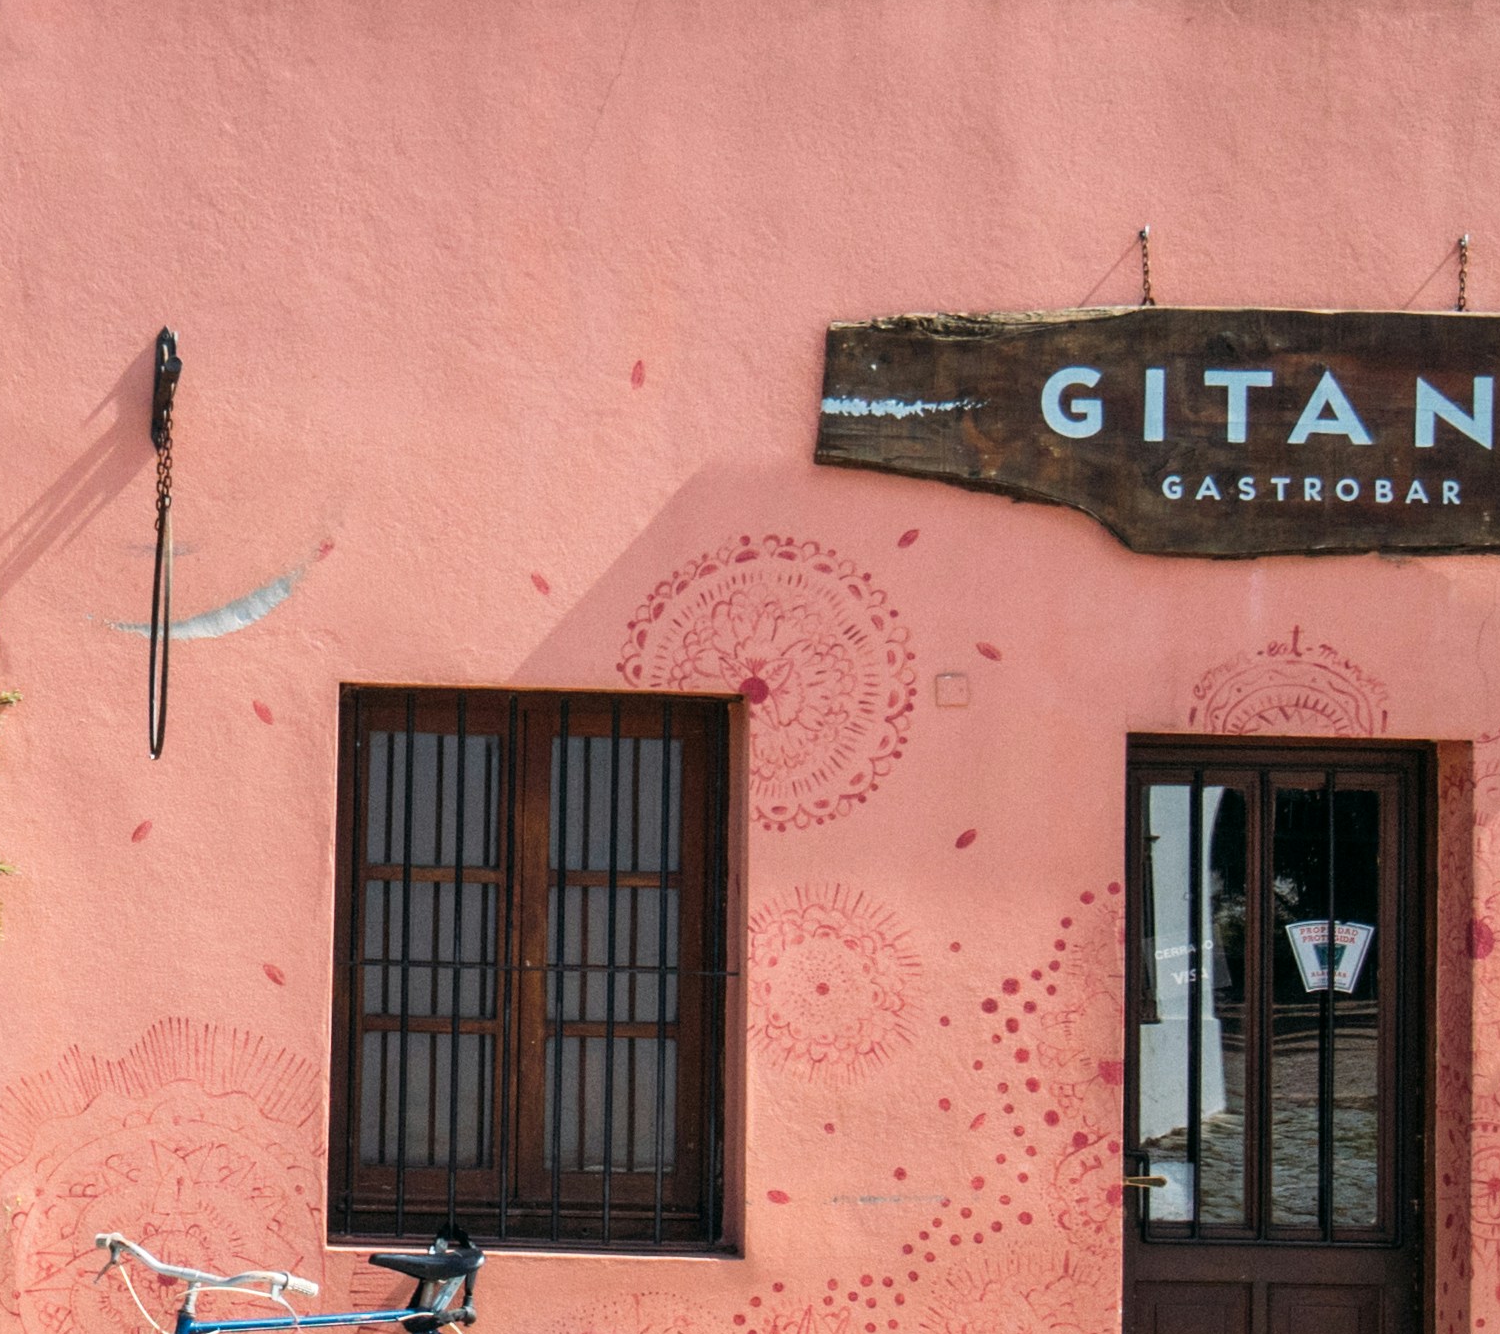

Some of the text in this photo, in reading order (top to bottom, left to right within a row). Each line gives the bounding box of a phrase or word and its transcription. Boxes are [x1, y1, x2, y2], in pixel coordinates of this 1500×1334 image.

[1160, 475, 1462, 505] GASTROBAR
[1300, 926, 1359, 936] PROPDAD
[1154, 939, 1214, 960] CERRAO
